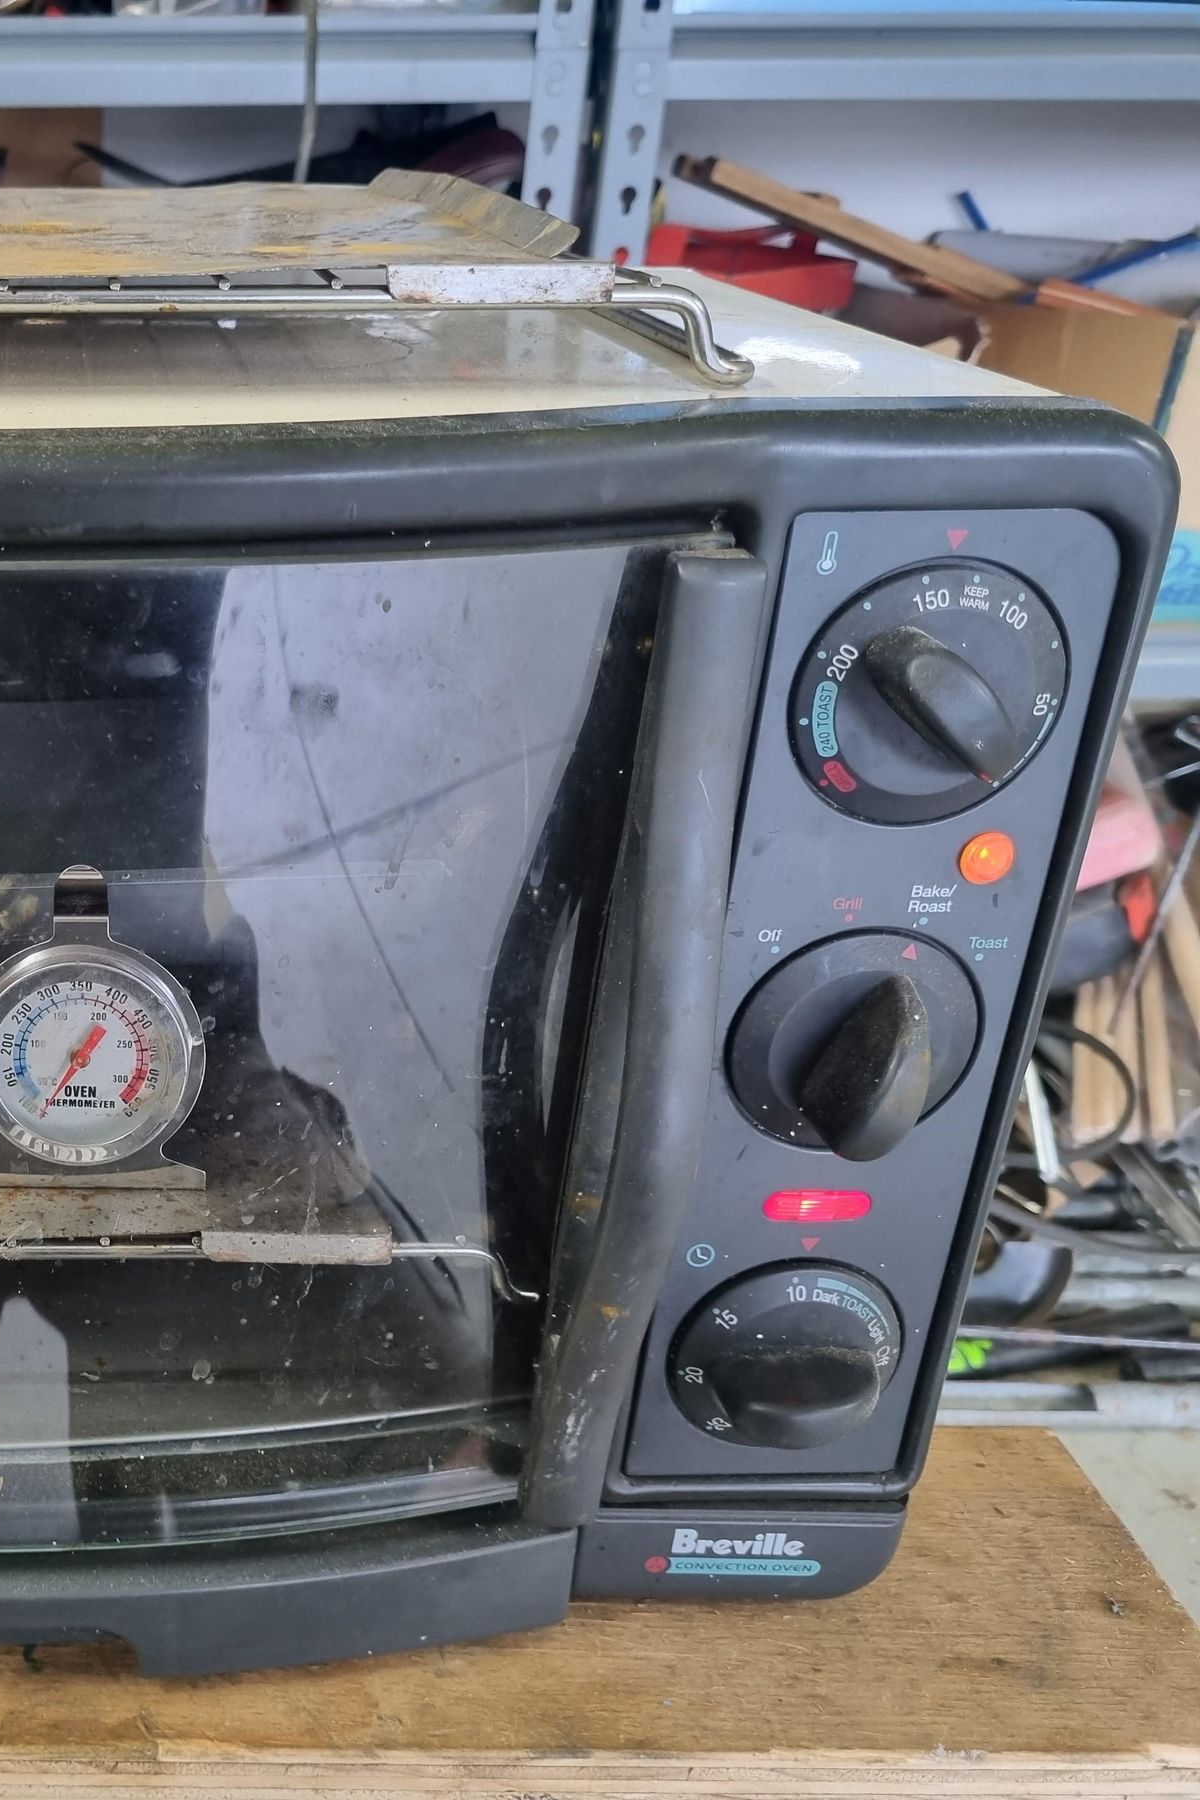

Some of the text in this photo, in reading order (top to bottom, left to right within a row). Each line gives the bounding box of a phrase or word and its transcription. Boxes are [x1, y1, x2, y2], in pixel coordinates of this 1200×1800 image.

[964, 586, 989, 597] KEEP
[913, 589, 950, 612] 150
[959, 597, 989, 611] WARM
[1000, 600, 1028, 630] 100
[827, 644, 859, 681] 200
[1033, 693, 1050, 716] 50
[816, 686, 834, 752] 240 TOAST
[911, 885, 957, 897] Bake/
[833, 897, 863, 911] Grill
[907, 901, 953, 913] Roast
[758, 929, 782, 942] Off
[969, 937, 1008, 949] Toast
[37, 984, 60, 1001] 300
[69, 981, 93, 992] 350
[105, 987, 128, 1004] 400
[11, 1003, 32, 1024] 250
[90, 1012, 107, 1021] 200
[134, 1009, 152, 1030] 450
[0, 1033, 14, 1056] 200
[117, 1040, 133, 1049] 250
[2, 1066, 18, 1088] 150
[112, 1074, 129, 1084] 300
[64, 1085, 97, 1098] OVEN
[714, 1308, 738, 1330] 15
[786, 1285, 891, 1367] 10 Dark TOAST Light Off
[684, 1366, 704, 1385] 20
[671, 1528, 805, 1556] Breville
[675, 1561, 813, 1573] CONVECTION OVEN
